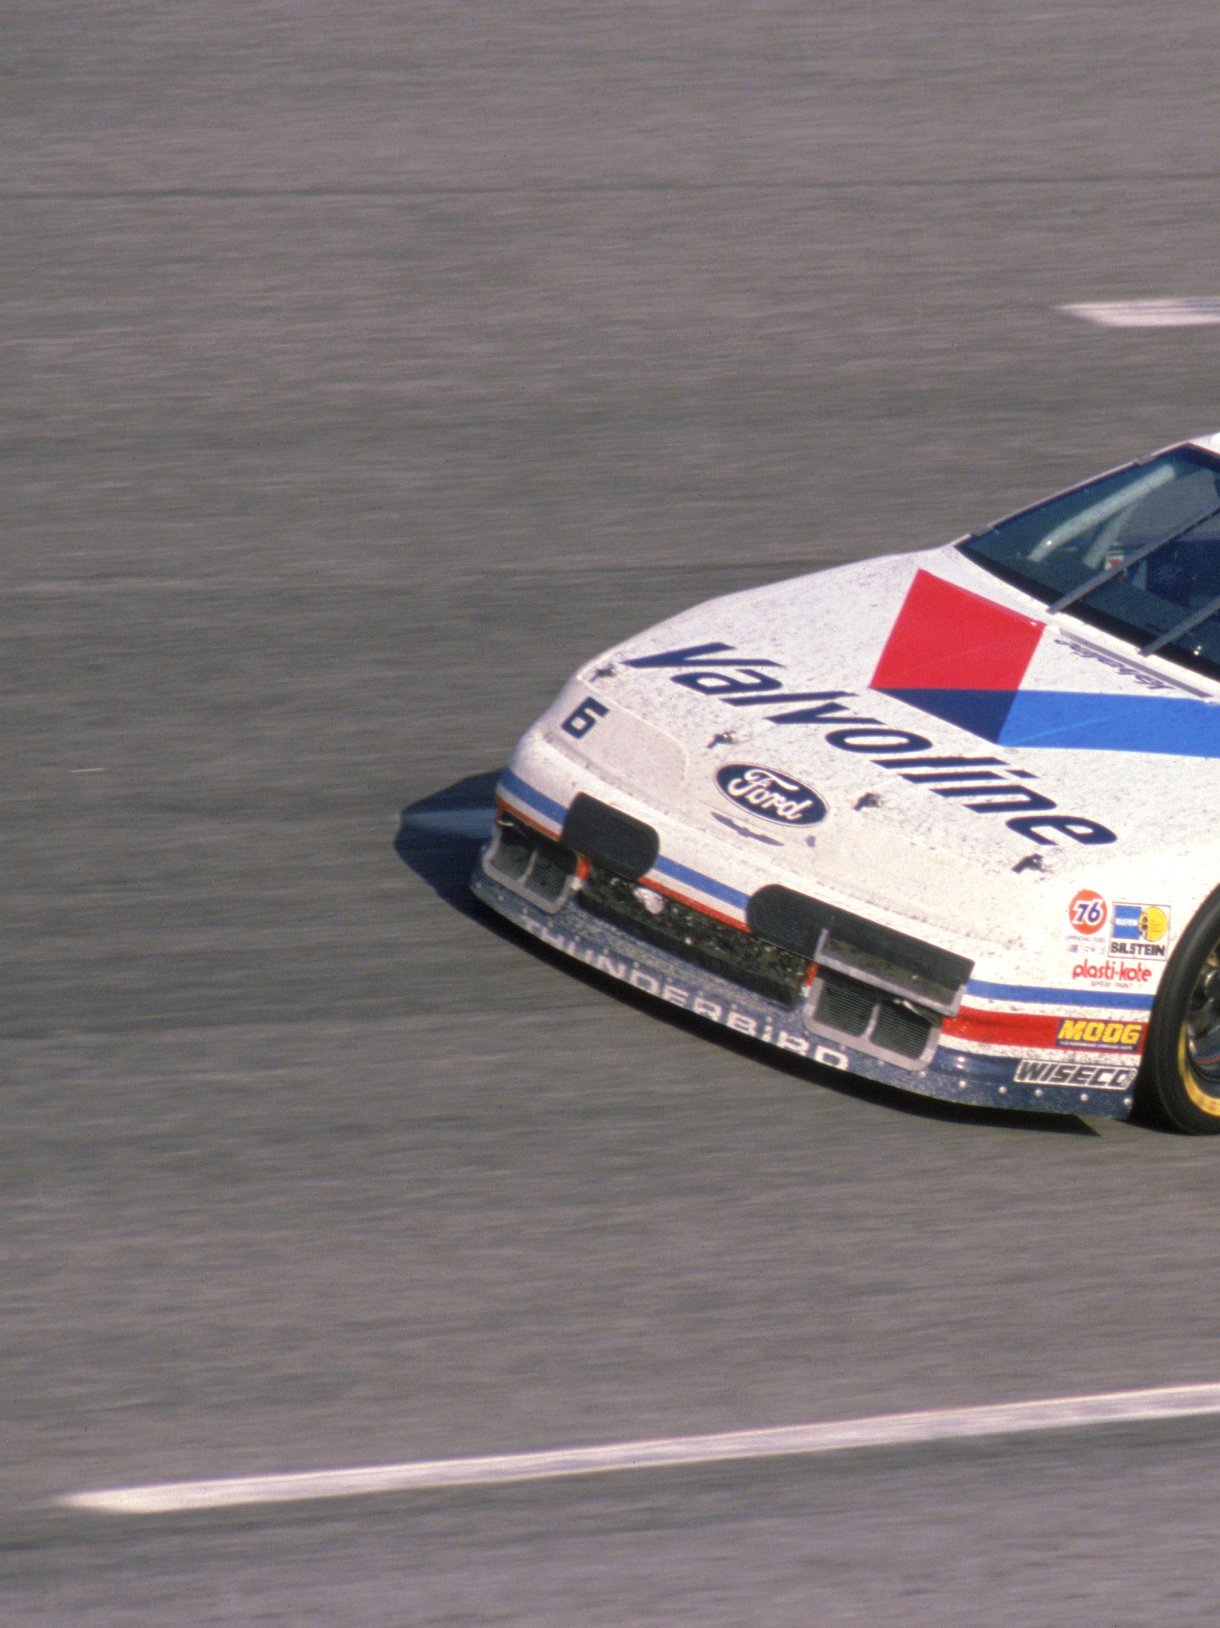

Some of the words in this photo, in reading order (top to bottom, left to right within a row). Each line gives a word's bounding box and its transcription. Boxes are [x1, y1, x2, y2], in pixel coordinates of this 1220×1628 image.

[560, 696, 609, 740] 6
[622, 642, 1118, 846] Valvoline
[727, 768, 814, 820] Ford
[1075, 900, 1102, 924] 76
[1110, 942, 1166, 957] BILSTEIN
[1072, 959, 1152, 982] plasti-kote
[1058, 1019, 1142, 1044] MOOG
[1016, 1060, 1137, 1090] WISECO
